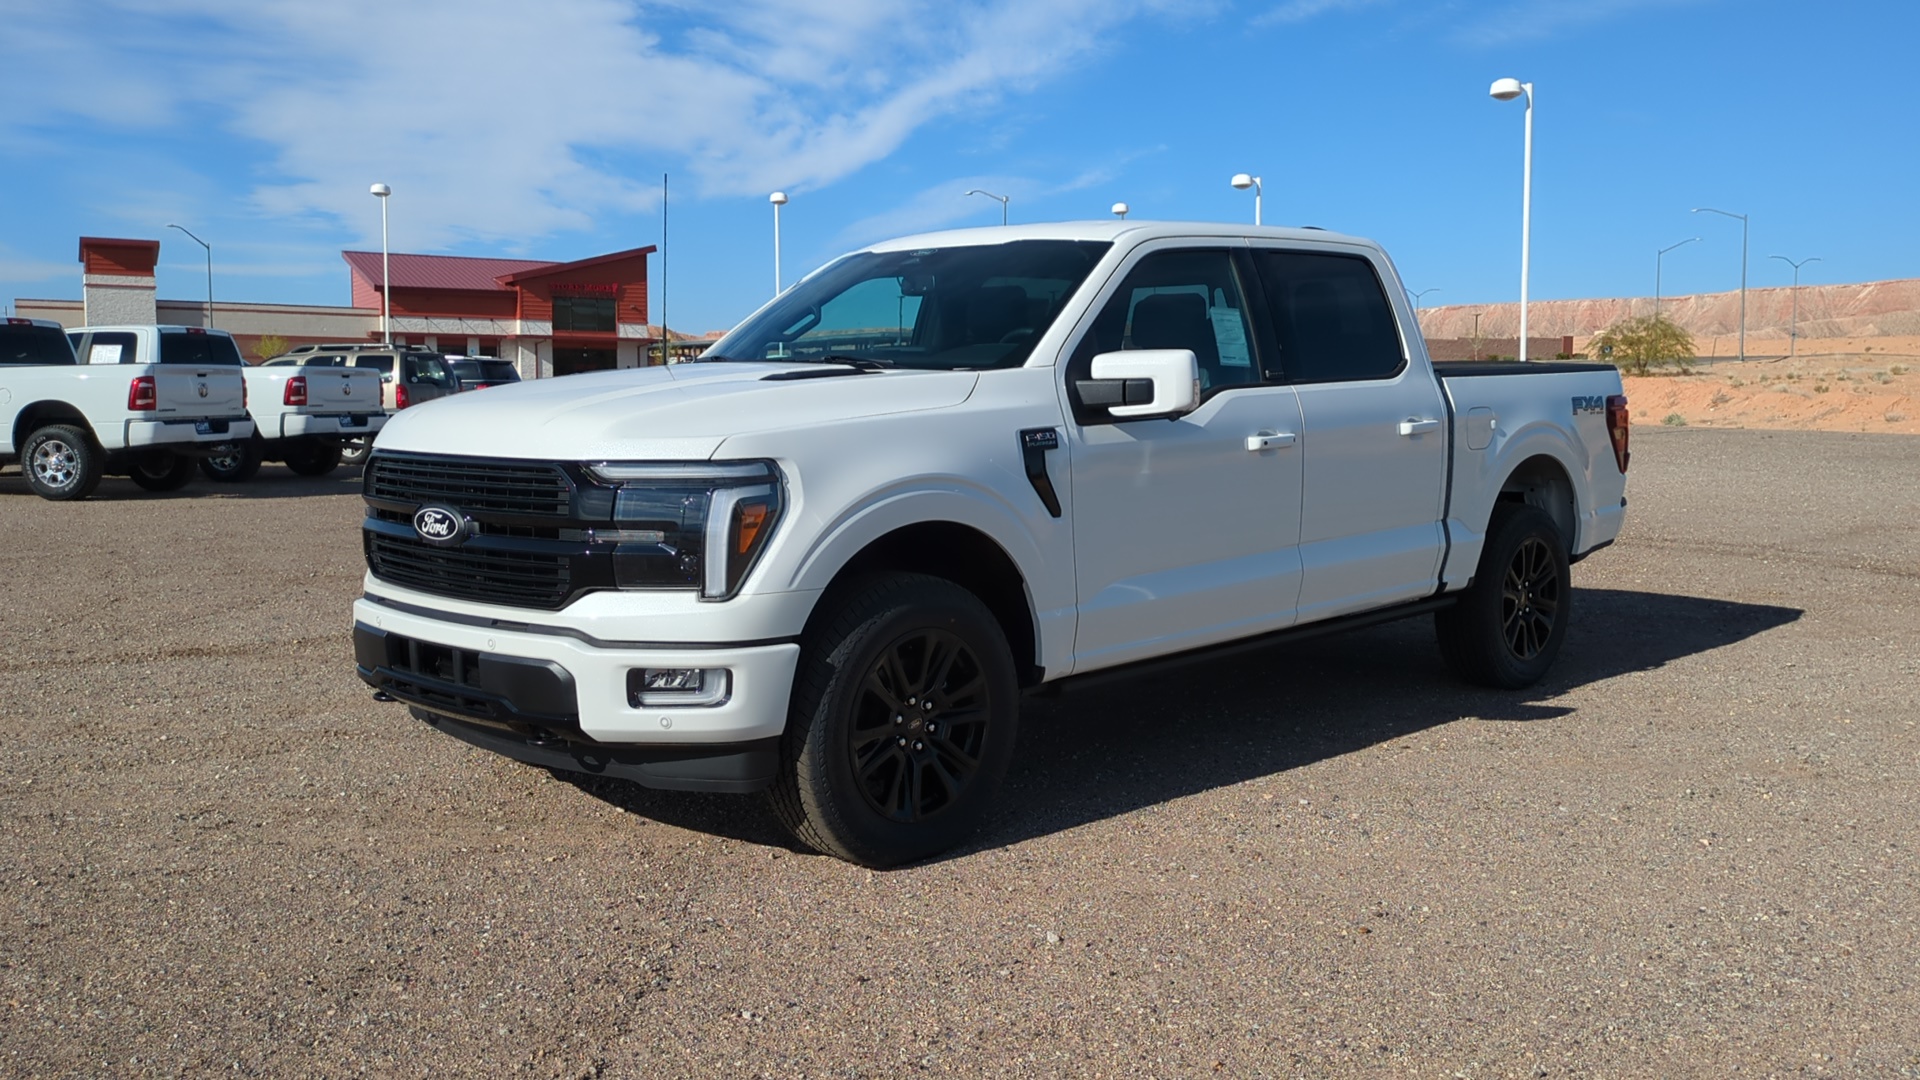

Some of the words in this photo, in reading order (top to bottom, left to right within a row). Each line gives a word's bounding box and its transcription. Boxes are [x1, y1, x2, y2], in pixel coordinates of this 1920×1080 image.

[1571, 396, 1604, 415] FX4
[1025, 432, 1056, 441] F-150
[421, 511, 449, 535] Ford
